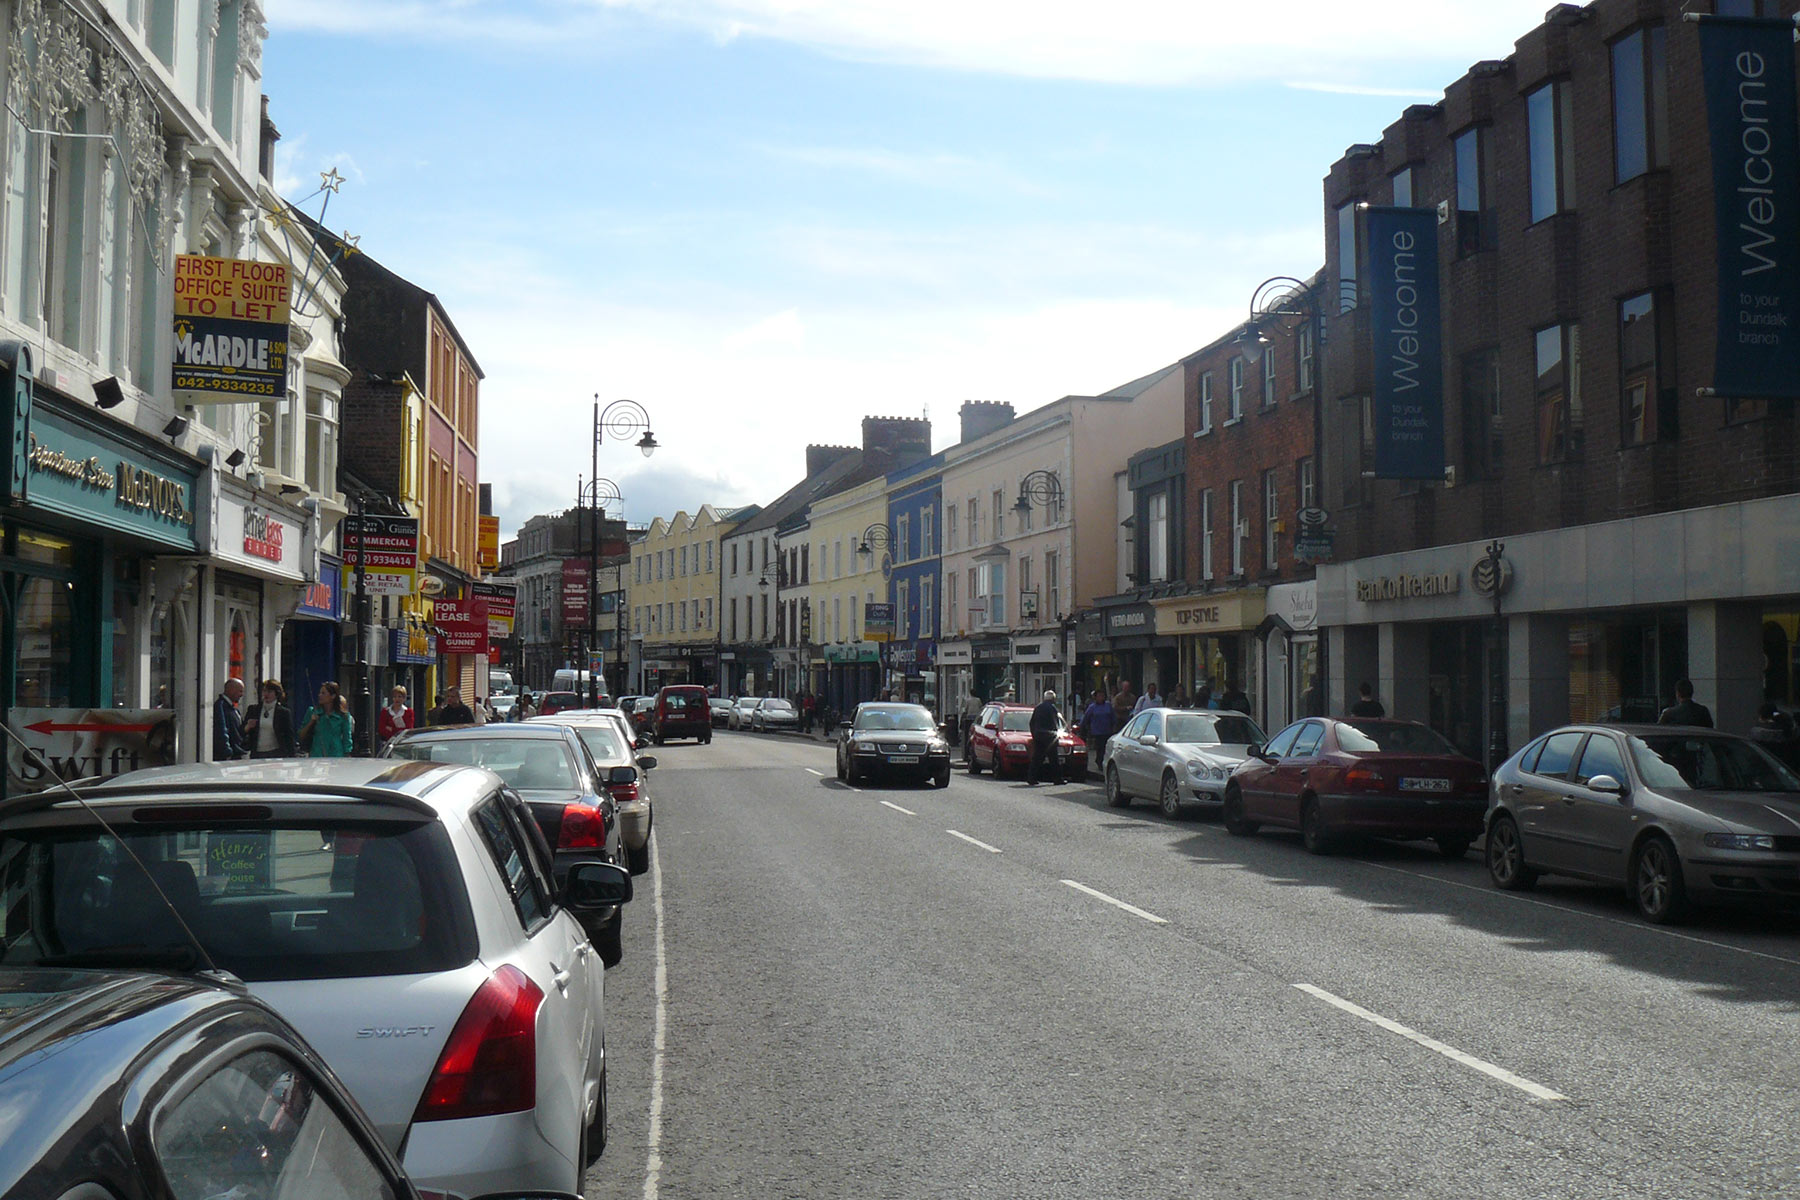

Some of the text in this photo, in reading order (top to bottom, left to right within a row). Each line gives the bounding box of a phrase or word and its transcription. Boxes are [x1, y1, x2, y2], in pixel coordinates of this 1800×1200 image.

[1736, 51, 1776, 276] Welcome
[177, 258, 285, 283] FIRST FLOOR
[174, 277, 287, 303] OFFICE SUITE
[183, 297, 276, 320] TO LET
[1739, 292, 1780, 309] to your
[1391, 230, 1419, 393] Welcome
[1739, 310, 1788, 327] Dundalk
[1739, 330, 1779, 345] branch
[172, 332, 269, 371] McARDLE
[177, 377, 274, 394] 042-9334235
[347, 553, 371, 564] (02)
[378, 574, 402, 582] LET
[1356, 569, 1457, 602] Bank of Ireland
[435, 603, 456, 611] FOR
[435, 613, 470, 621] LEASE
[1175, 606, 1219, 626] TOP STYLE
[21, 747, 143, 780] Swift
[222, 859, 256, 870] Coffee
[356, 1025, 436, 1039] SWIFT
